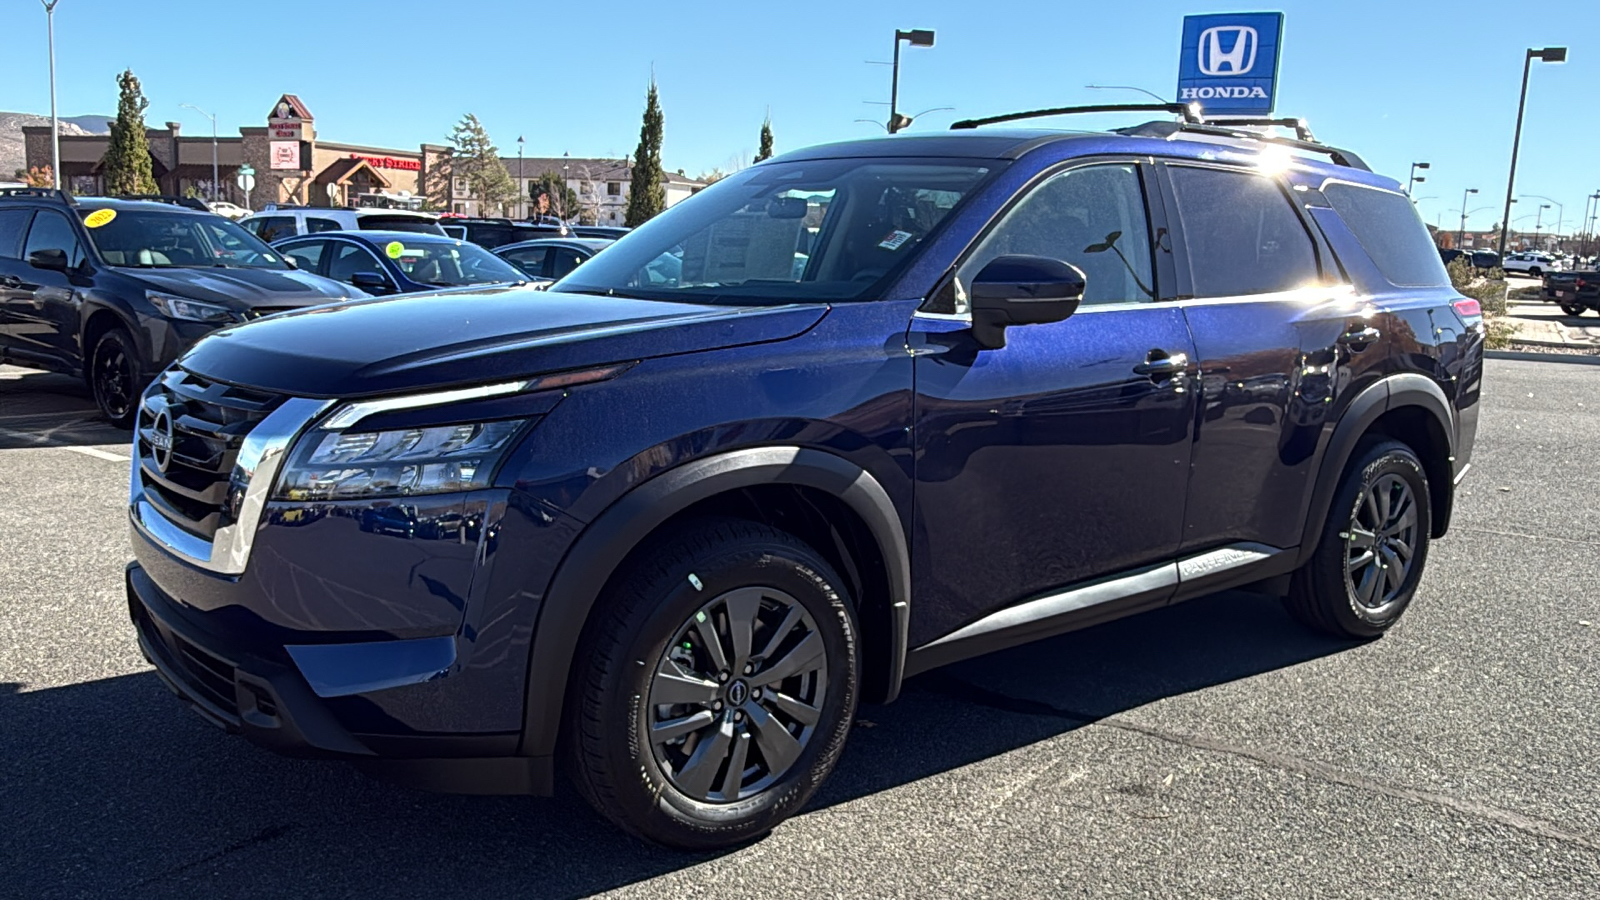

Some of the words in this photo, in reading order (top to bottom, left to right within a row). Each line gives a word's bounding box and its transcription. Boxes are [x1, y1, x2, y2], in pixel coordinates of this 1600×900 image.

[1180, 86, 1269, 99] HONDA
[385, 156, 421, 170] STRIKE
[91, 211, 111, 224] 2022
